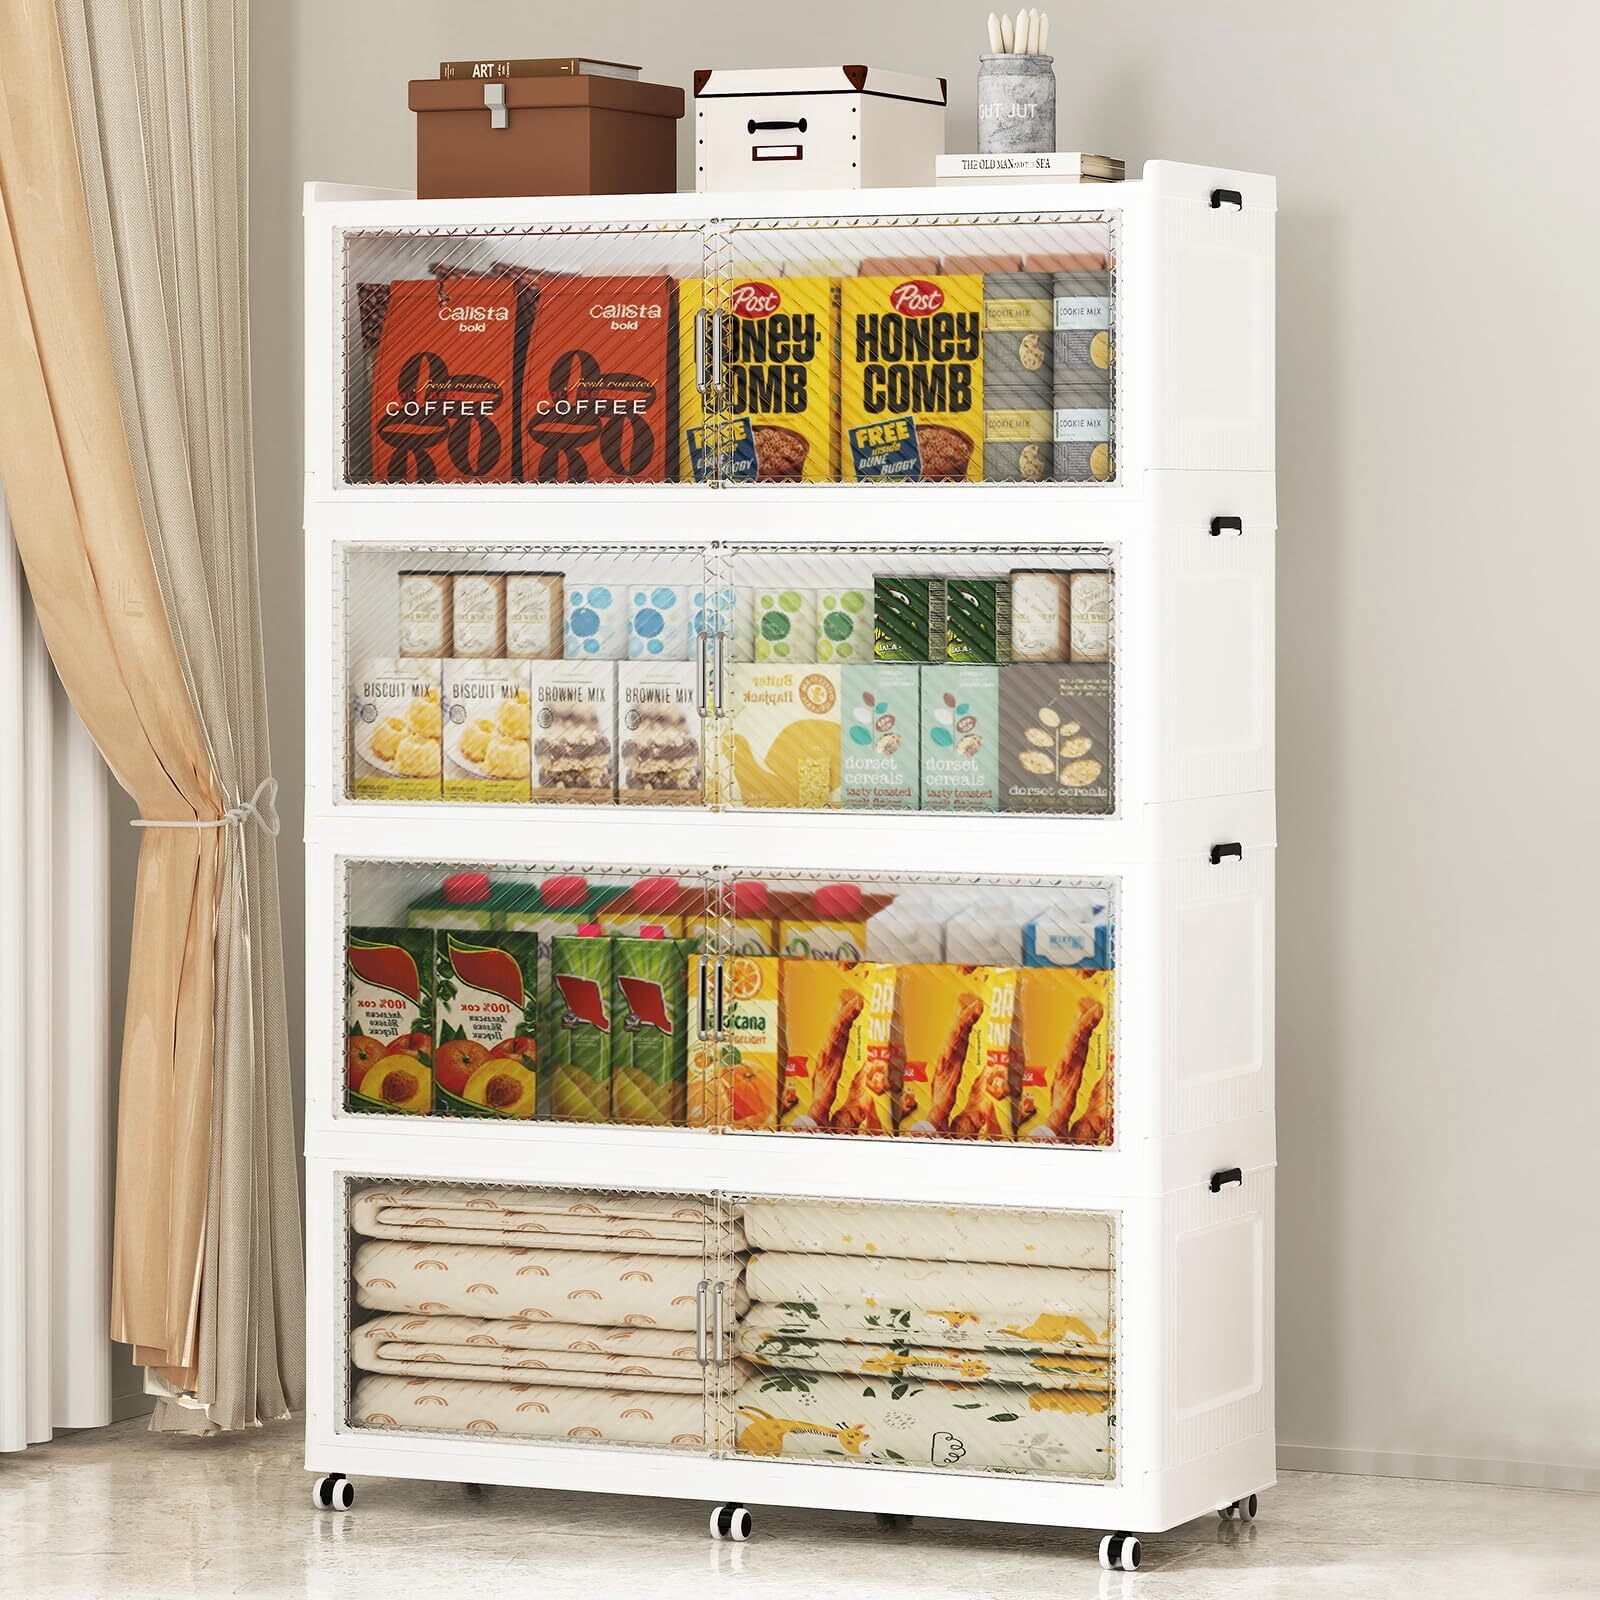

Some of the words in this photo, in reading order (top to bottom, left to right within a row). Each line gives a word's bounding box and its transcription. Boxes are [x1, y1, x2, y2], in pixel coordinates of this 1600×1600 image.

[472, 64, 494, 78] ART
[1008, 103, 1038, 119] JUT
[979, 159, 996, 169] OLD
[997, 159, 1014, 169] MAN
[1036, 158, 1051, 169] SEA
[731, 285, 778, 311] Post
[894, 284, 941, 311] Post
[1060, 307, 1084, 316] COOKIE
[1087, 307, 1101, 316] MIX
[459, 323, 486, 332] bold
[611, 321, 638, 330] bold
[413, 379, 451, 393] fresh
[454, 380, 505, 390] roasted
[564, 378, 604, 391] fresh
[607, 378, 658, 388] roasted
[863, 364, 972, 414] COMB
[386, 401, 494, 416] COFFEE
[536, 400, 647, 415] COFFEE
[1060, 419, 1084, 428] COOKIE
[1087, 419, 1101, 428] MIX
[855, 419, 910, 449] FREE
[859, 454, 889, 470] DUNE
[881, 459, 917, 476] BUGGY
[364, 682, 406, 698] BISCUIT
[412, 683, 431, 698] MIX
[453, 684, 495, 699] BISCUIT
[501, 684, 520, 699] MIX
[538, 686, 582, 702] BROWNIE
[588, 688, 606, 702] MIX
[626, 687, 671, 703] BROWNIE
[676, 688, 694, 703] MIX
[845, 756, 898, 770] dorset
[926, 758, 979, 771] dorset
[845, 773, 904, 786] cereals
[926, 774, 985, 787] cereals
[1009, 785, 1054, 795] dorset
[1057, 787, 1108, 797] cereals
